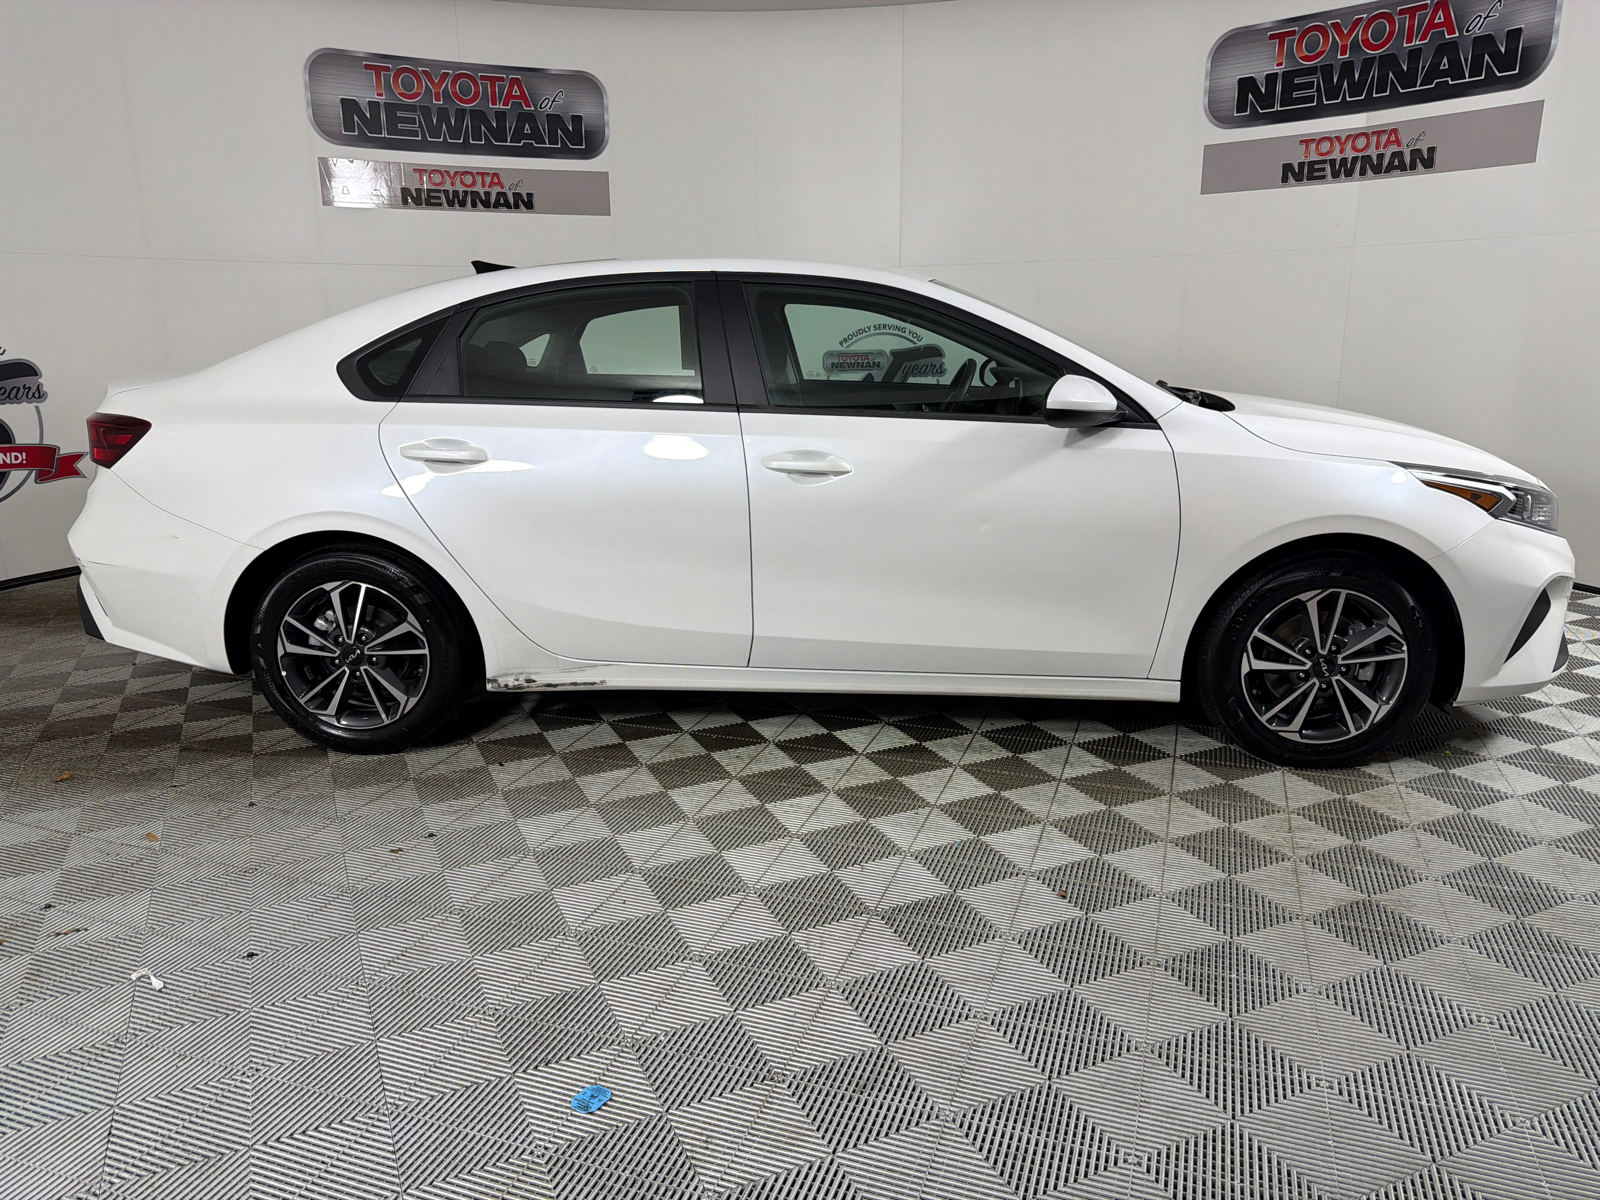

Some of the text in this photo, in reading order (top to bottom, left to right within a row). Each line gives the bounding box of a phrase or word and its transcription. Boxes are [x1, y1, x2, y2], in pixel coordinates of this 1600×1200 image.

[1268, 0, 1503, 67] TOYOTA of
[1234, 25, 1524, 116] NEWNAN
[363, 62, 564, 111] TOYOTA of
[339, 97, 586, 149] NEWNAN
[1299, 126, 1427, 159] TOYOTA of
[1280, 145, 1437, 184] NEWNAN
[412, 168, 524, 191] TOYOTA of
[400, 187, 534, 211] NEWNAN
[838, 323, 924, 347] PROUDLY SERVING YOU
[830, 361, 881, 369] NEWNAN
[836, 354, 869, 362] TOYOTA
[901, 362, 945, 380] years
